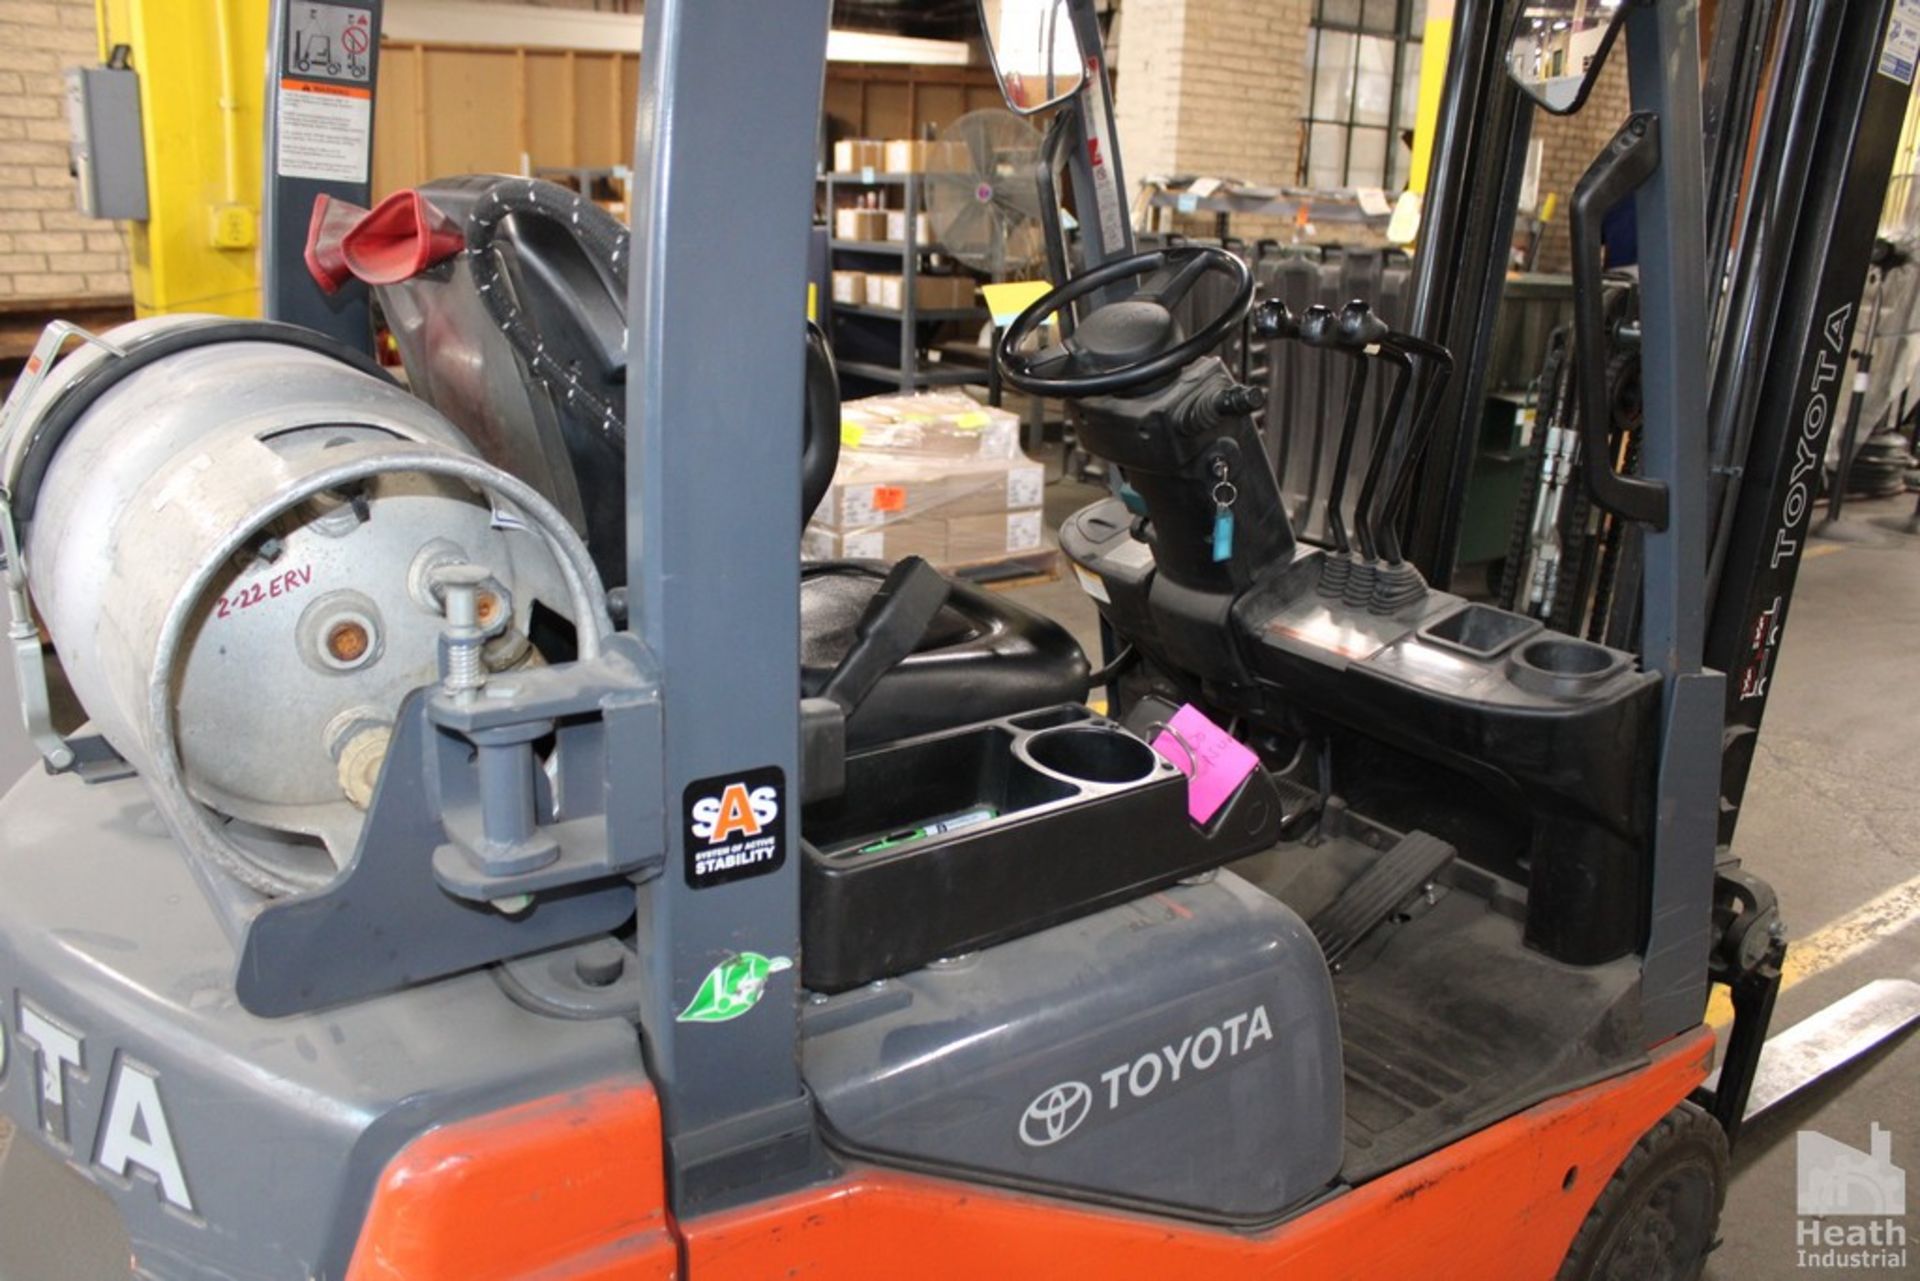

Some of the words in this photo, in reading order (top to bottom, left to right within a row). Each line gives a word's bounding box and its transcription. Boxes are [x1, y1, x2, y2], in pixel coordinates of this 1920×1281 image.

[1770, 301, 1851, 569] TOYOTA
[691, 782, 778, 845] SAS
[695, 846, 730, 861] SYSTEM
[730, 843, 743, 853] OF
[744, 836, 775, 851] ACTIVE
[695, 845, 775, 875] STABILITY
[1101, 1004, 1274, 1110] TOYOTA
[0, 994, 203, 1220] TA
